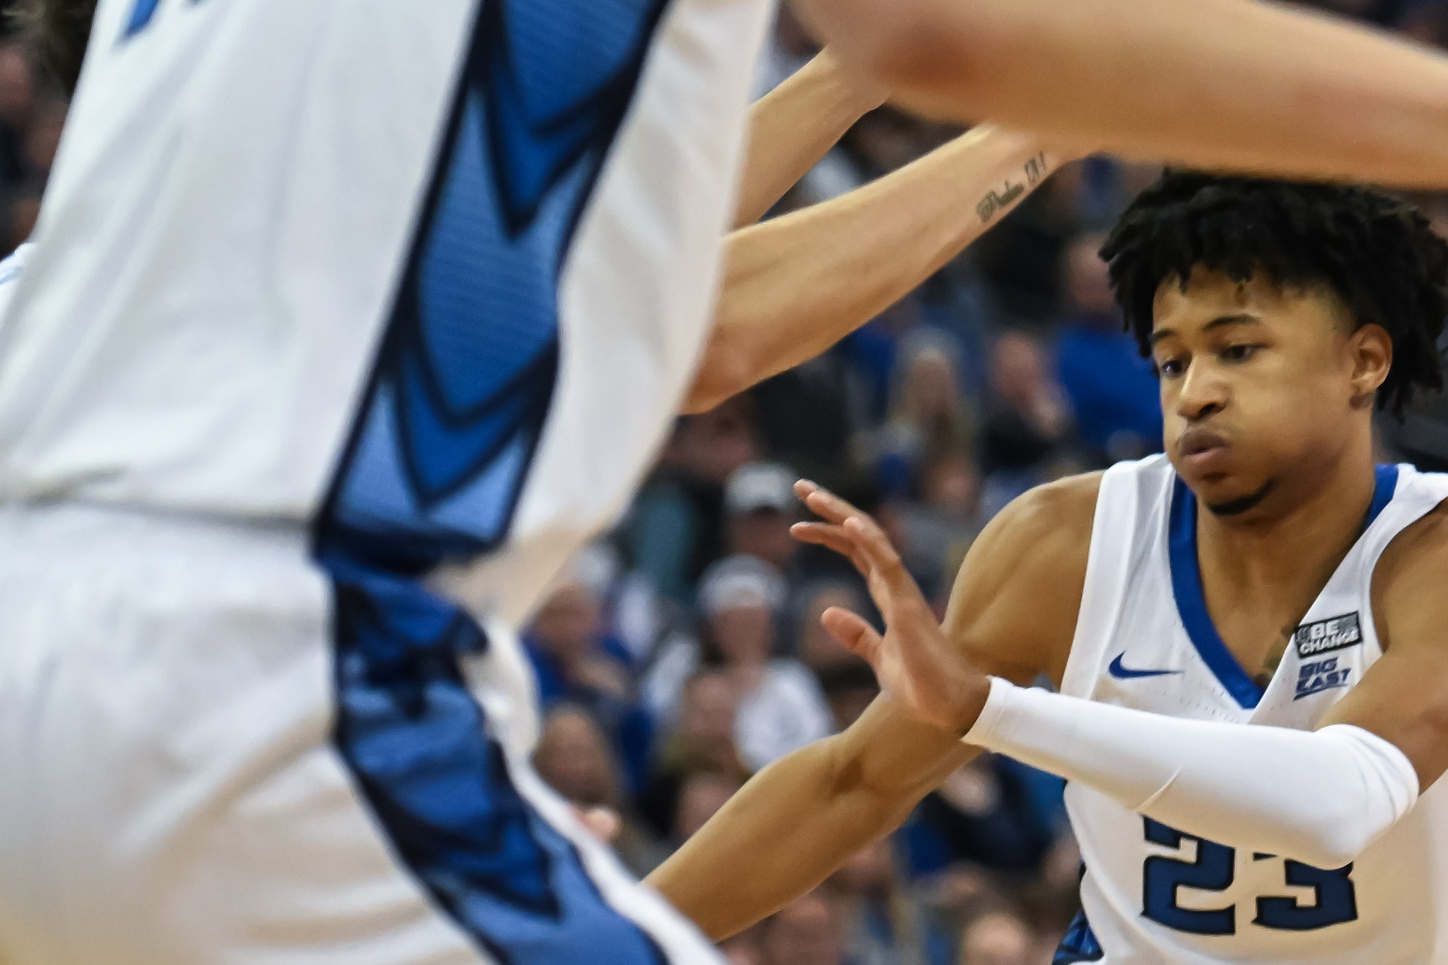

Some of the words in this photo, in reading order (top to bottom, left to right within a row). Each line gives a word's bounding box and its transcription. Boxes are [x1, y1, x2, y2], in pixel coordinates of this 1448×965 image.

[1310, 619, 1341, 640] BE
[1299, 657, 1339, 679] BIG
[1296, 668, 1351, 693] EAST
[1140, 814, 1359, 936] 23
